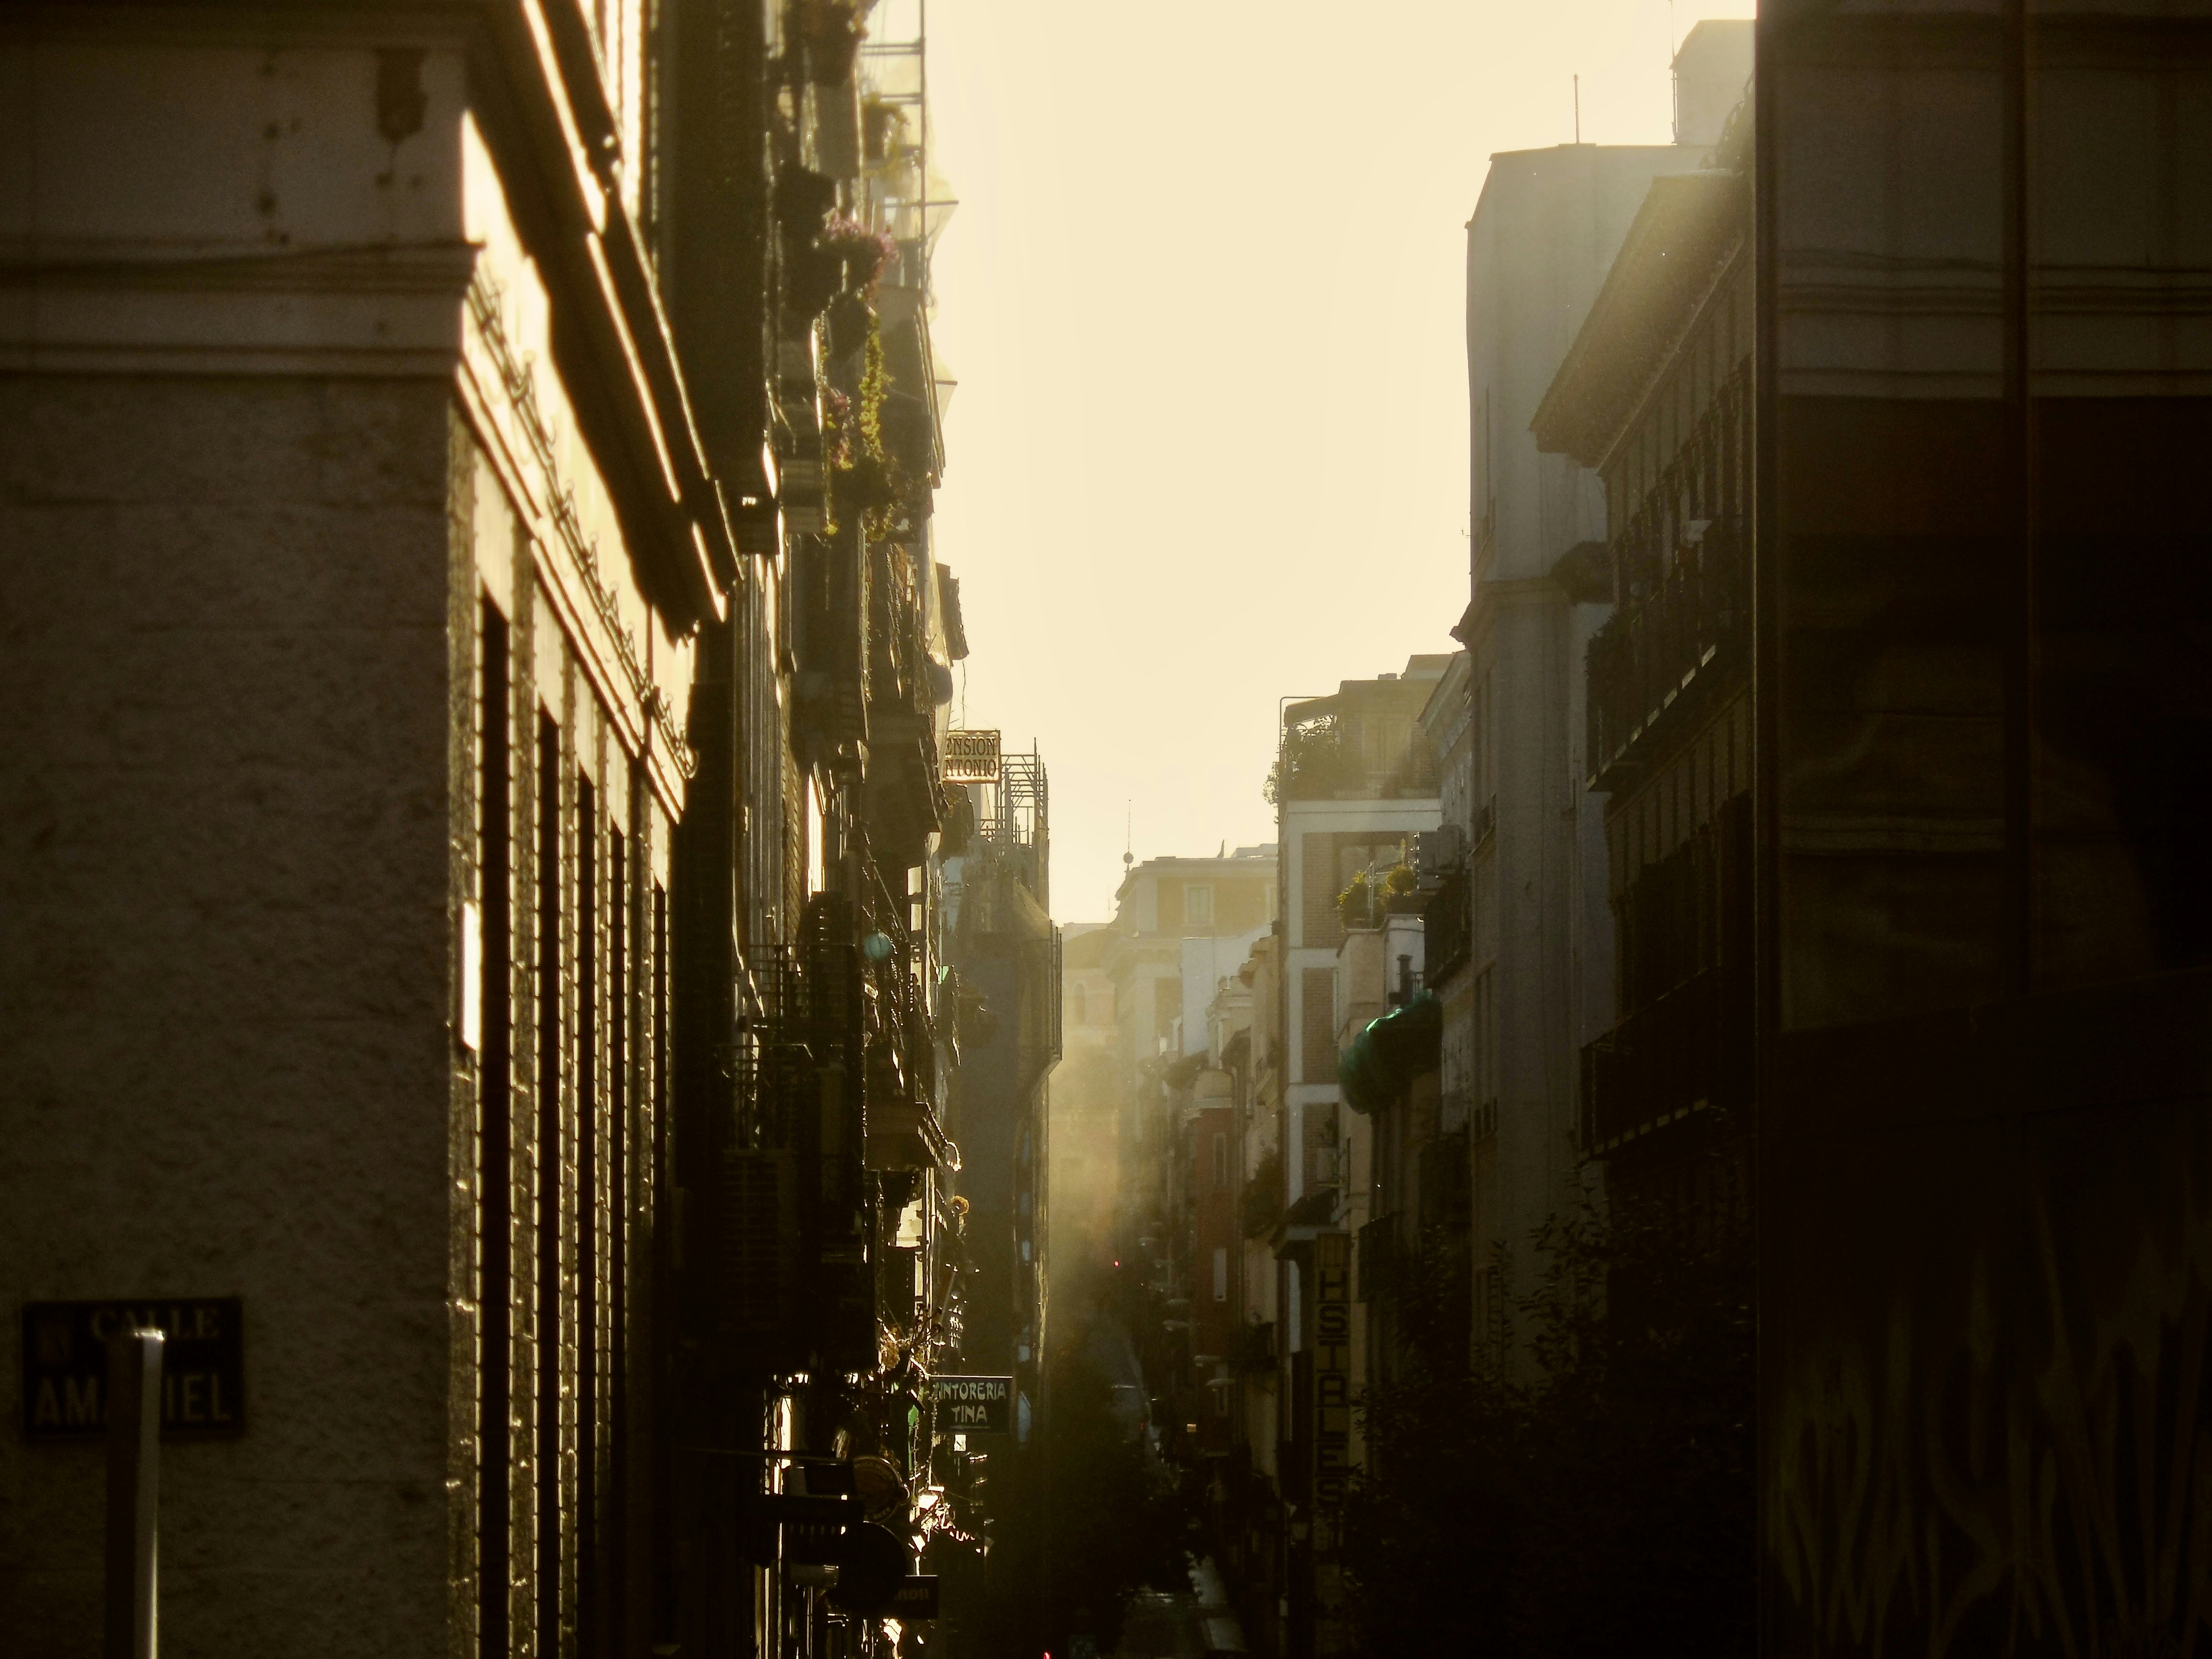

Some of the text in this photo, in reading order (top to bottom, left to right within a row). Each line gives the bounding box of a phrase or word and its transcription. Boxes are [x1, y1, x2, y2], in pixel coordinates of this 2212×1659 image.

[945, 738, 996, 755] ENSION
[945, 759, 996, 777] NTONIO
[34, 1372, 232, 1426] AMIEL
[951, 1406, 987, 1423] TINA
